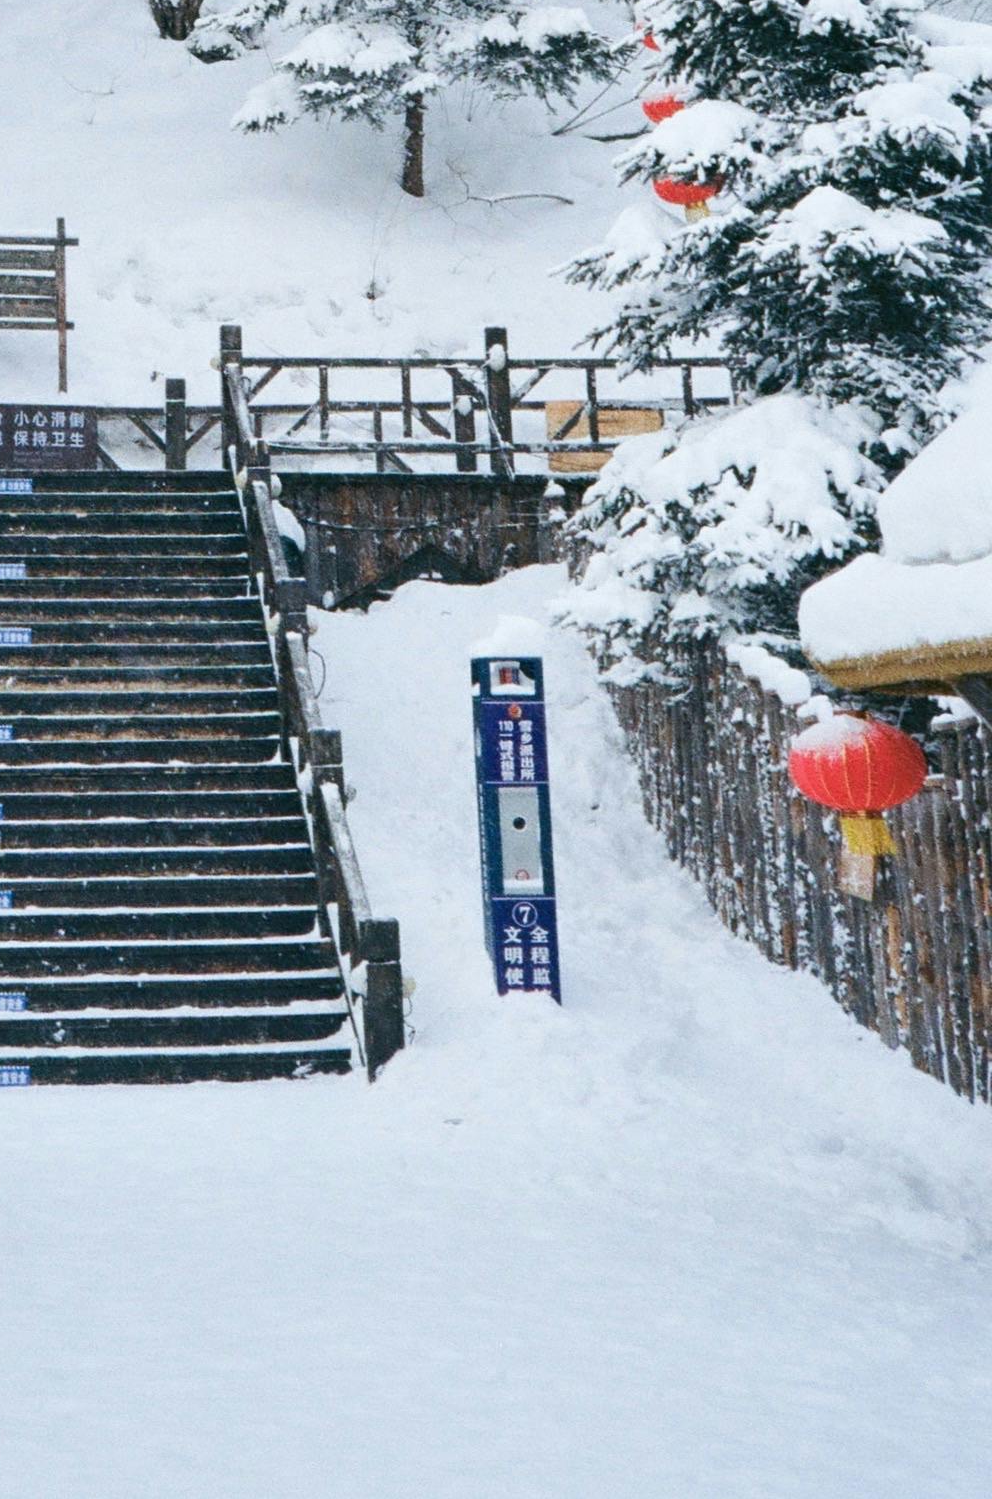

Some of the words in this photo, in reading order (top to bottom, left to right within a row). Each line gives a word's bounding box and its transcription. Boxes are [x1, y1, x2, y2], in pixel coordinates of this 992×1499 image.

[14, 410, 85, 429] 小心滑倒
[14, 430, 85, 448] 保持卫生
[519, 906, 531, 925] 7
[503, 926, 525, 989] 文明使
[530, 926, 552, 989] 全程监
